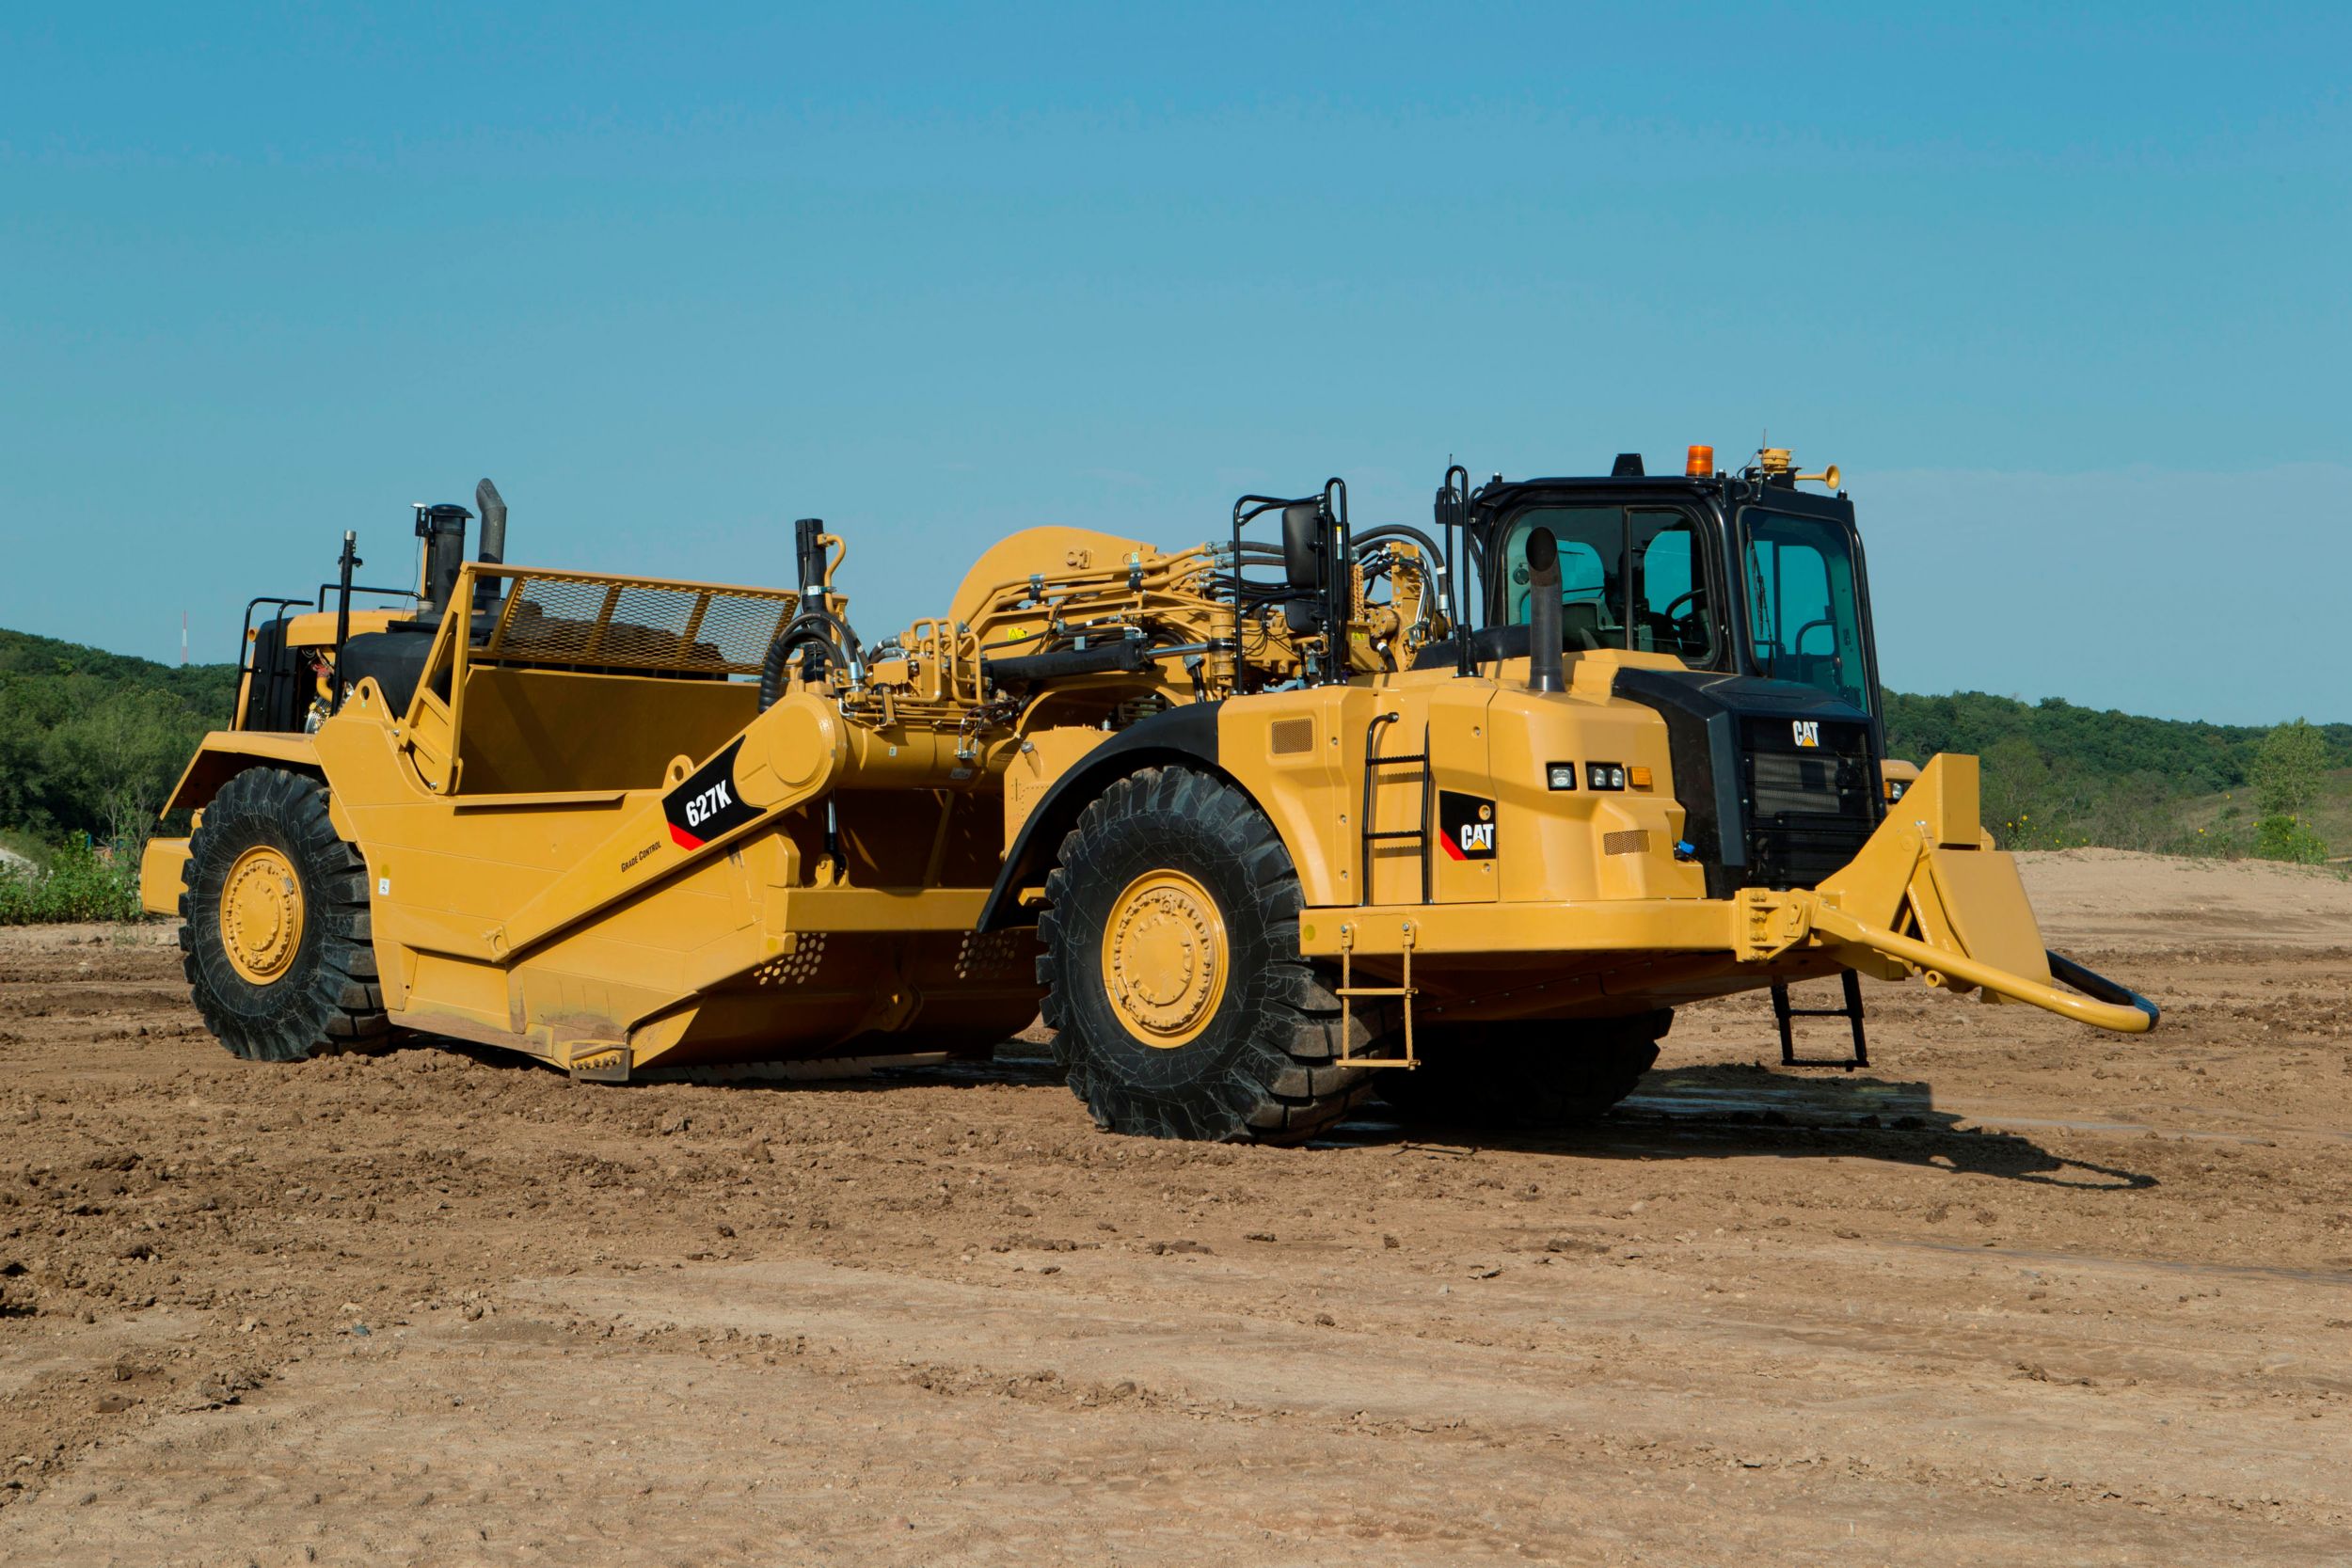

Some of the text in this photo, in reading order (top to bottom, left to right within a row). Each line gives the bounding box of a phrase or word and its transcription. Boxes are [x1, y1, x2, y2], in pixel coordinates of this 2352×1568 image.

[1792, 721, 1820, 747] CAT
[686, 779, 733, 827] 627K
[1461, 823, 1494, 850] CAT
